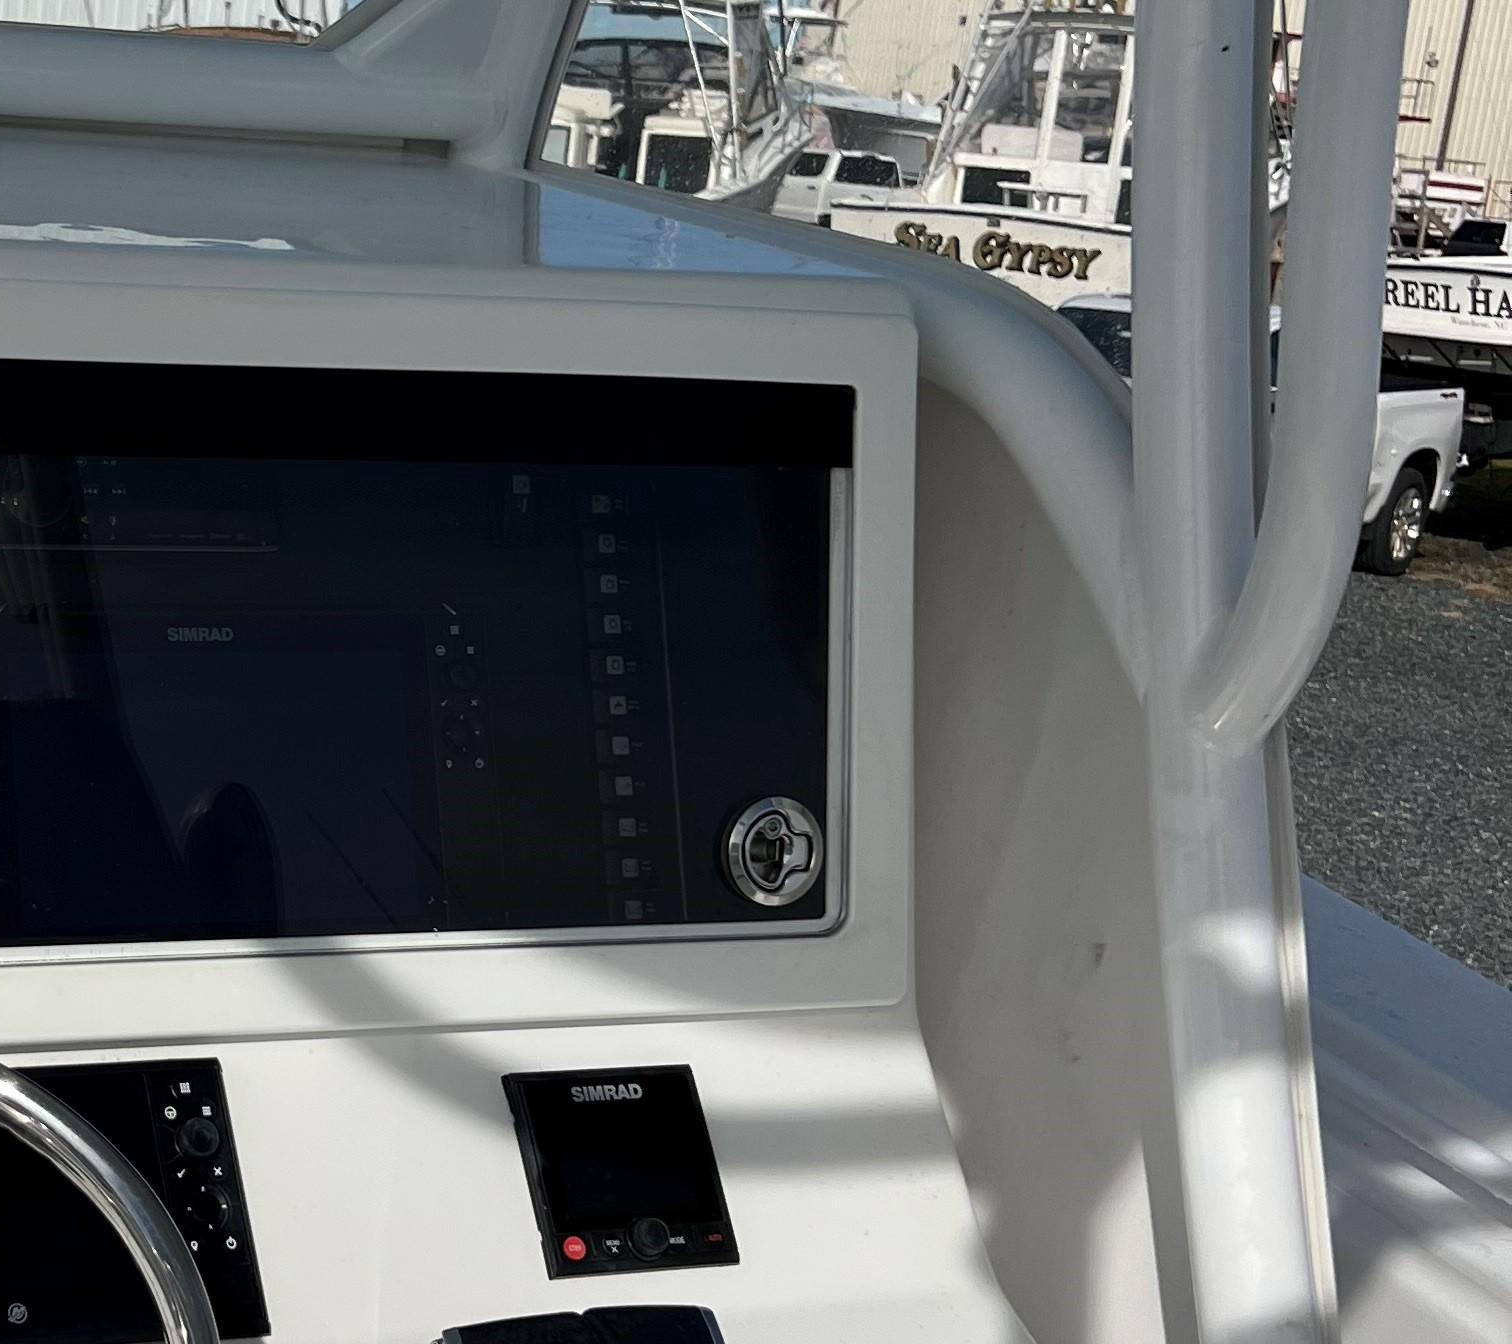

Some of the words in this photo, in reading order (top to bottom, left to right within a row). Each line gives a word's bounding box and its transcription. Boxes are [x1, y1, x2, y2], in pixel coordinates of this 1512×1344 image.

[1384, 277, 1461, 314] REEL
[168, 627, 234, 642] SIMRAD
[571, 1083, 643, 1102] SIMRAD
